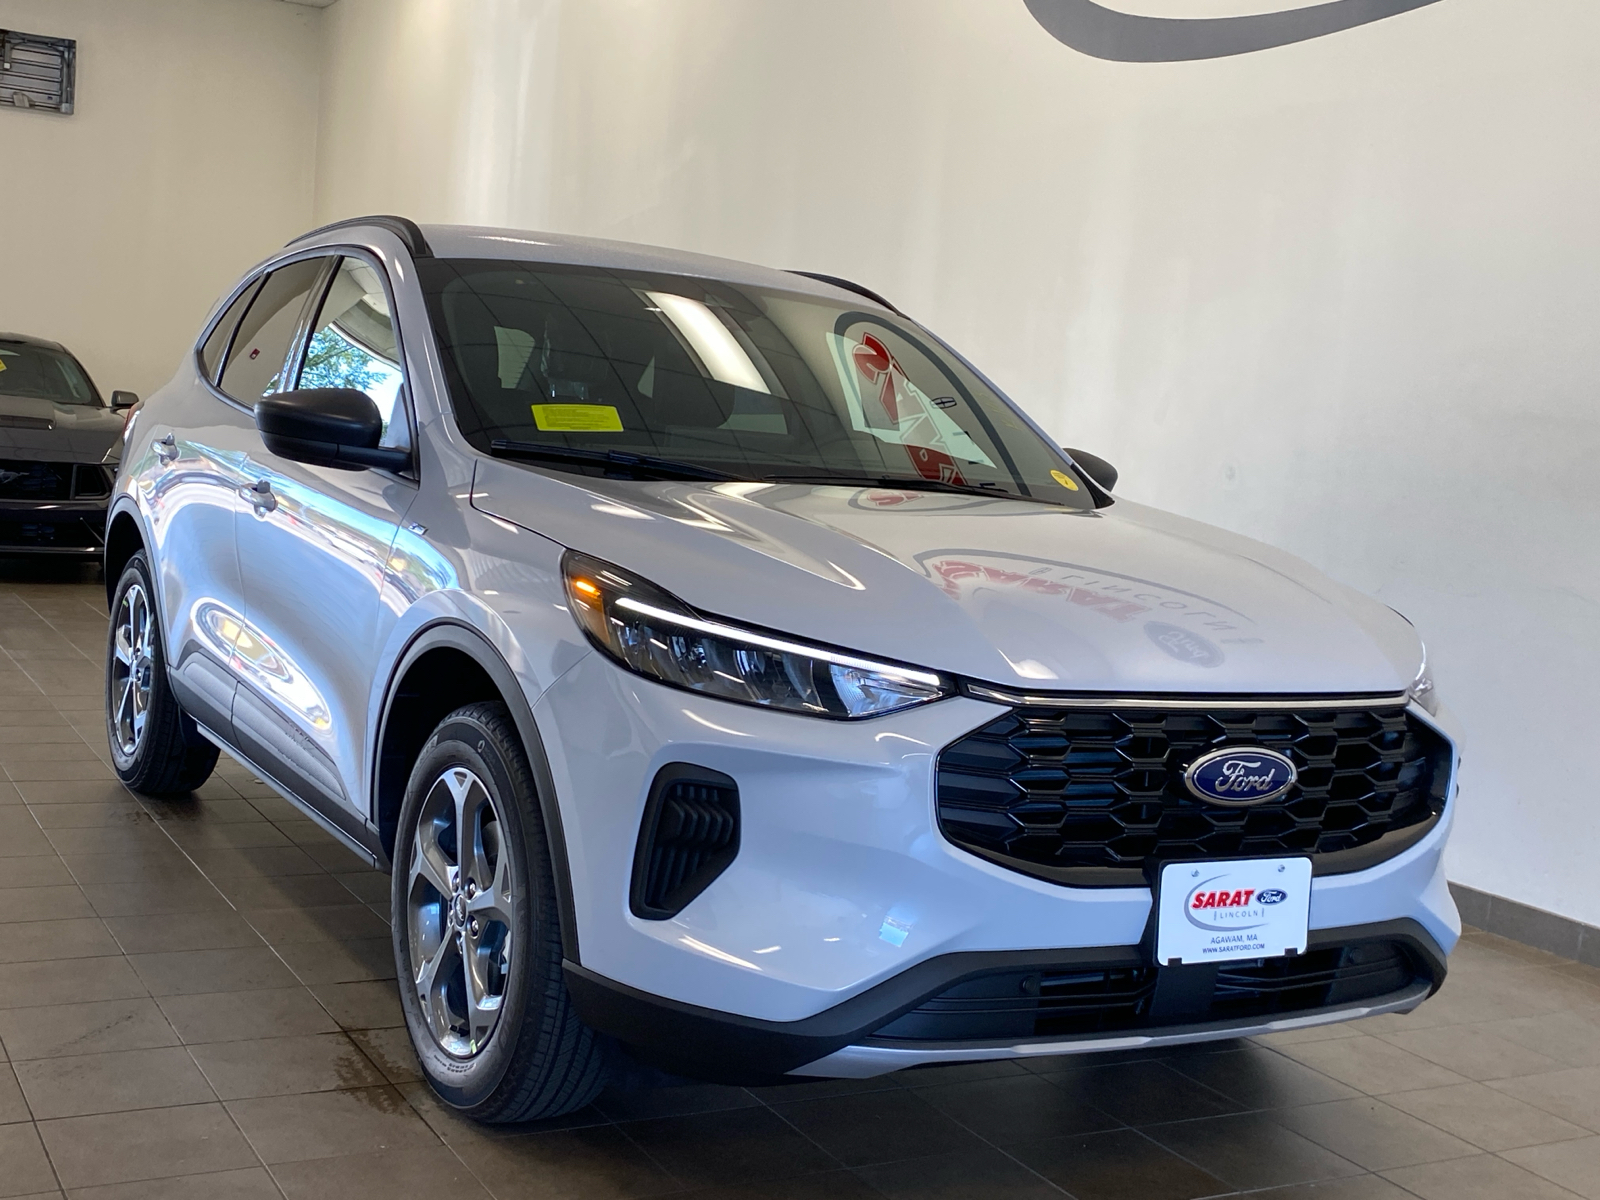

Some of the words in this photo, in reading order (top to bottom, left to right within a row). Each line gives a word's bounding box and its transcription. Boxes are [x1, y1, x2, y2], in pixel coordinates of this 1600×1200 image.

[1215, 760, 1276, 792] Ford
[1191, 888, 1255, 909] SARAT
[1261, 890, 1281, 903] Ford
[1220, 911, 1258, 919] LINCOLN
[1210, 935, 1245, 944] AGAWAM,
[1202, 943, 1265, 954] WWW.SARATFORD.COM
